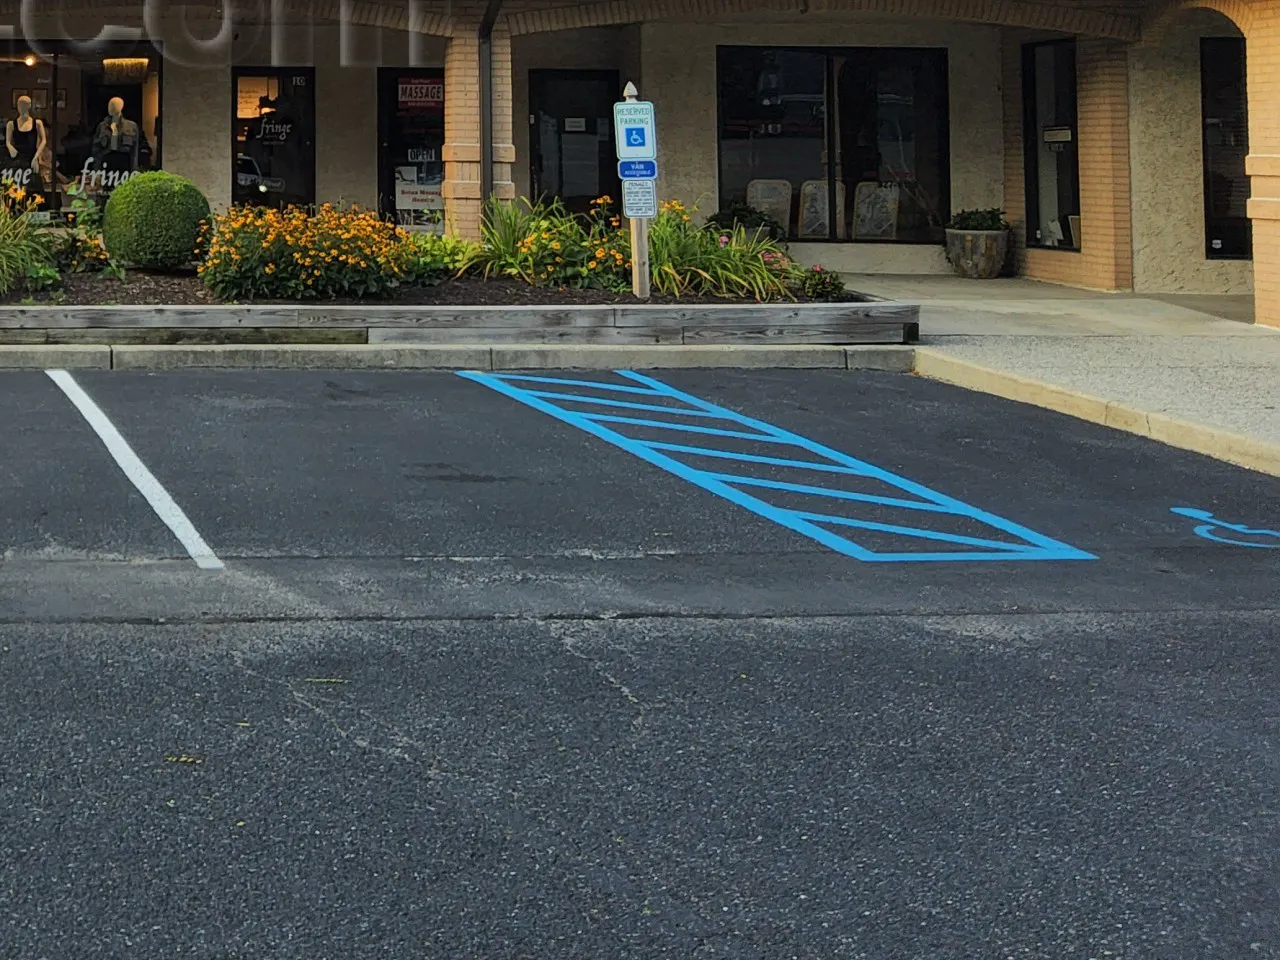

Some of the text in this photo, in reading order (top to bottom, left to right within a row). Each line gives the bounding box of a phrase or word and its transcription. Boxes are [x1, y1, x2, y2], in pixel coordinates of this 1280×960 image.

[400, 86, 442, 99] MASSAGE
[617, 107, 650, 116] RESERVED
[620, 117, 649, 125] PARKING
[255, 117, 293, 141] fringe
